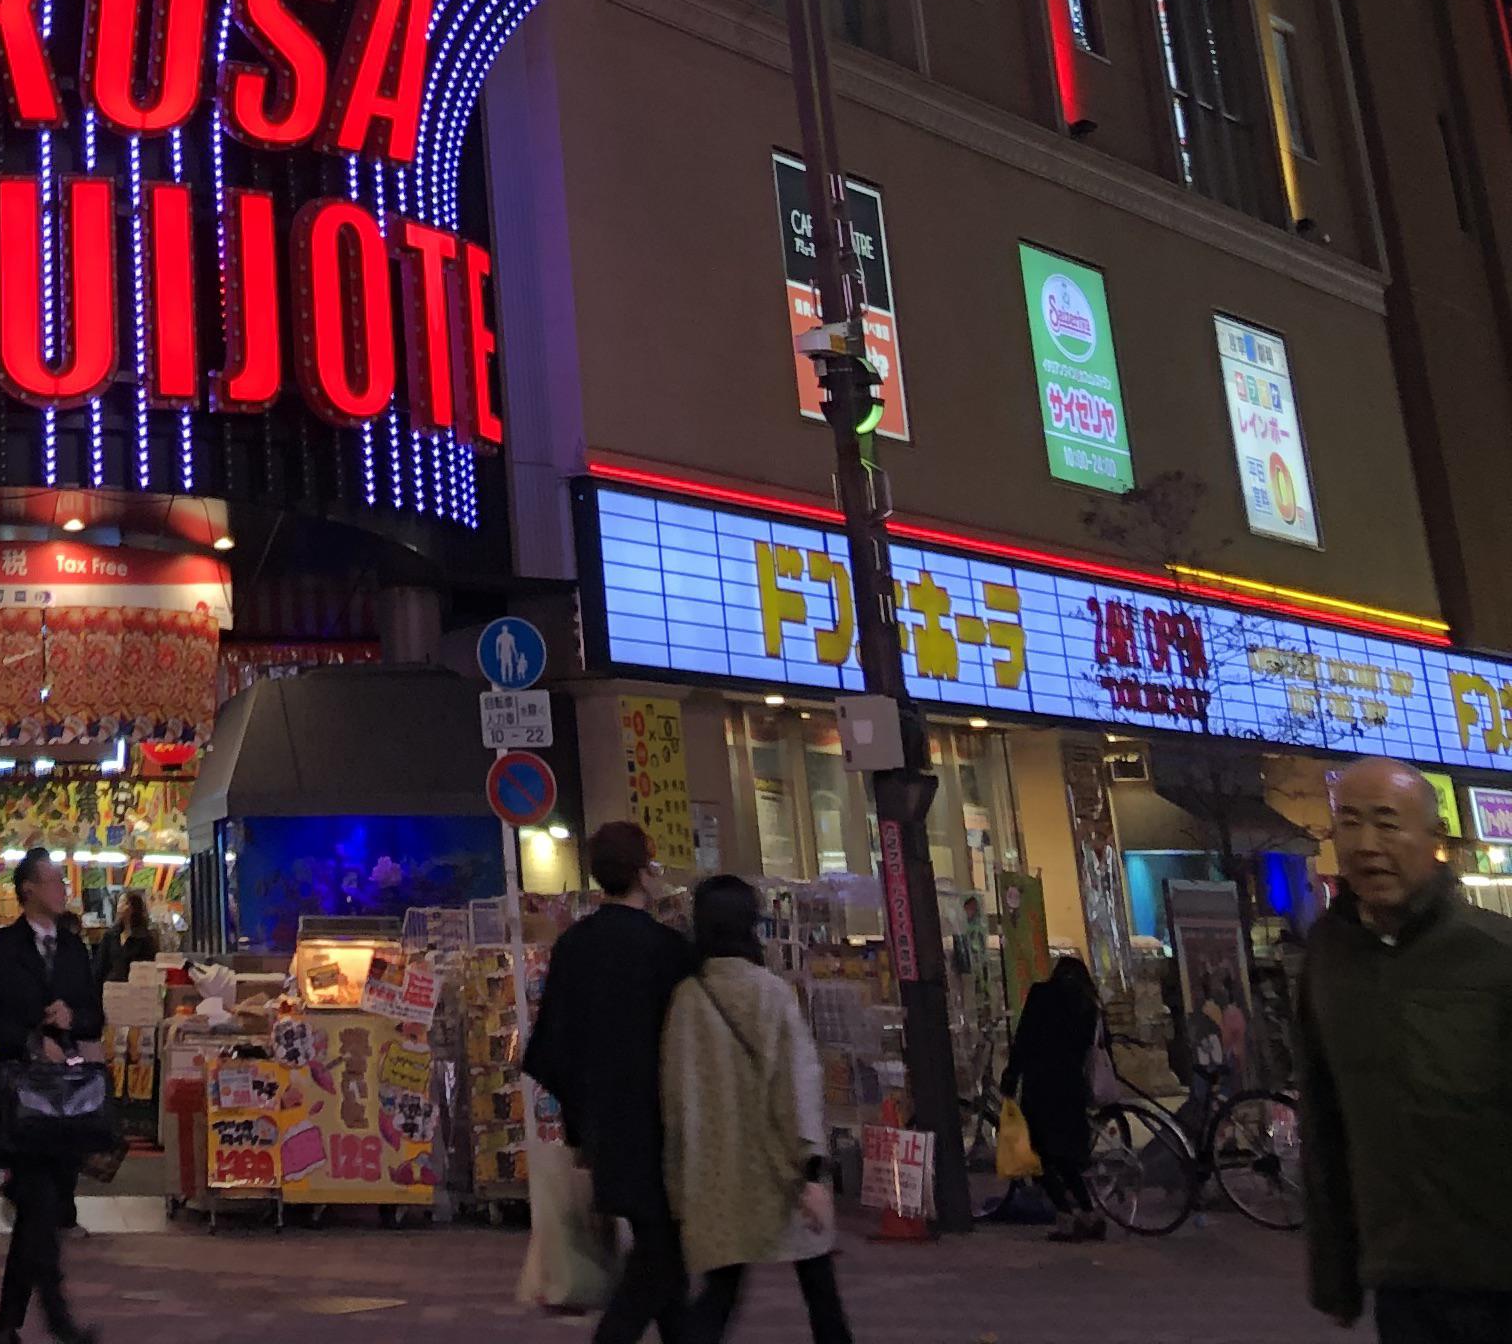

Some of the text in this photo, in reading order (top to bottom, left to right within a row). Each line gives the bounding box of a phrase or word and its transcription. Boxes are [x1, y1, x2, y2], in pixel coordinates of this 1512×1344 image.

[1047, 382, 1117, 443] サイゼリヤ
[56, 555, 128, 576] Tax Free
[490, 729, 505, 744] 10
[526, 729, 545, 743] 22
